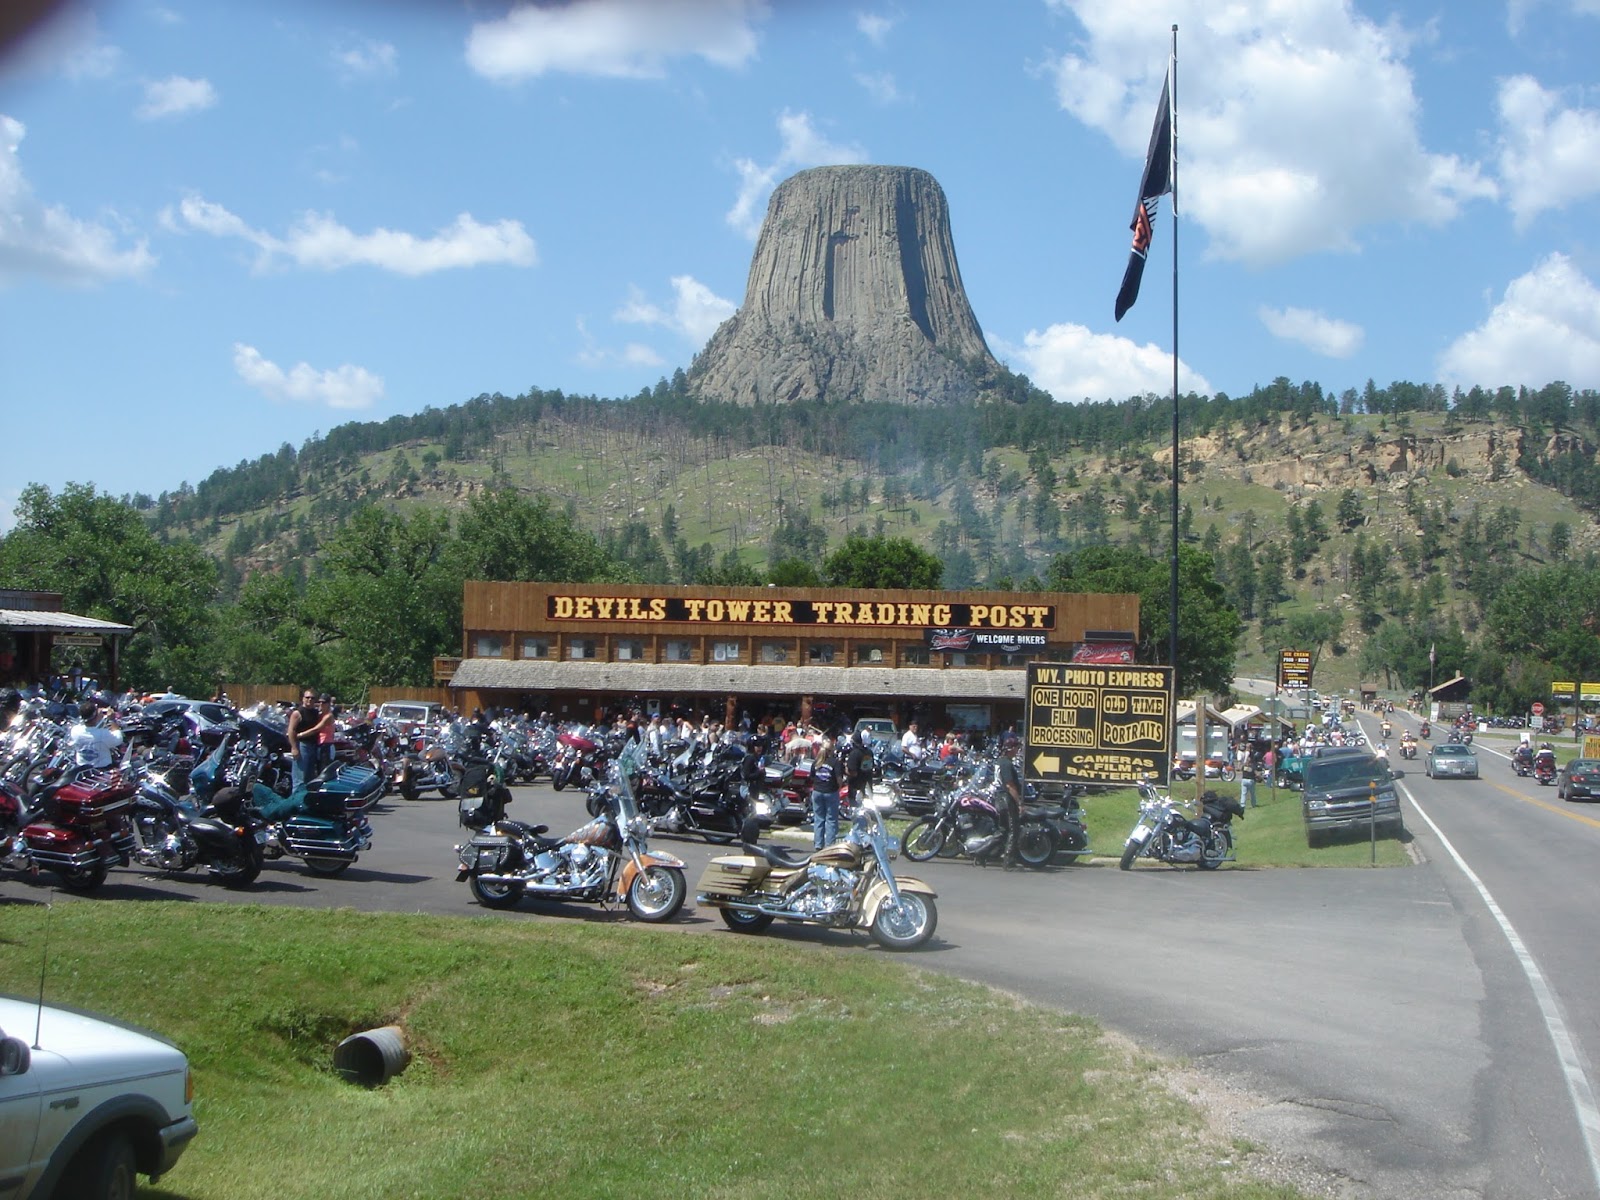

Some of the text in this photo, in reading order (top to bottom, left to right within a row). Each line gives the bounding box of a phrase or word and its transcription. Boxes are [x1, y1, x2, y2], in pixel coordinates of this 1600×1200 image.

[554, 596, 1050, 628] DEVILS TOWER TRADING POST
[976, 634, 1015, 644] WELCOME
[1017, 635, 1046, 645] BIKERS
[1037, 669, 1164, 688] WY. PHOTO EXPRESS
[1034, 690, 1095, 708] ONE HOUR
[1104, 696, 1164, 714] OLD TIME
[1052, 709, 1076, 726] FILM
[1033, 728, 1093, 745] PROCESSING
[1104, 721, 1162, 743] PORTRAITS
[1072, 755, 1154, 767] CAMERAS
[1094, 763, 1131, 772] FILM
